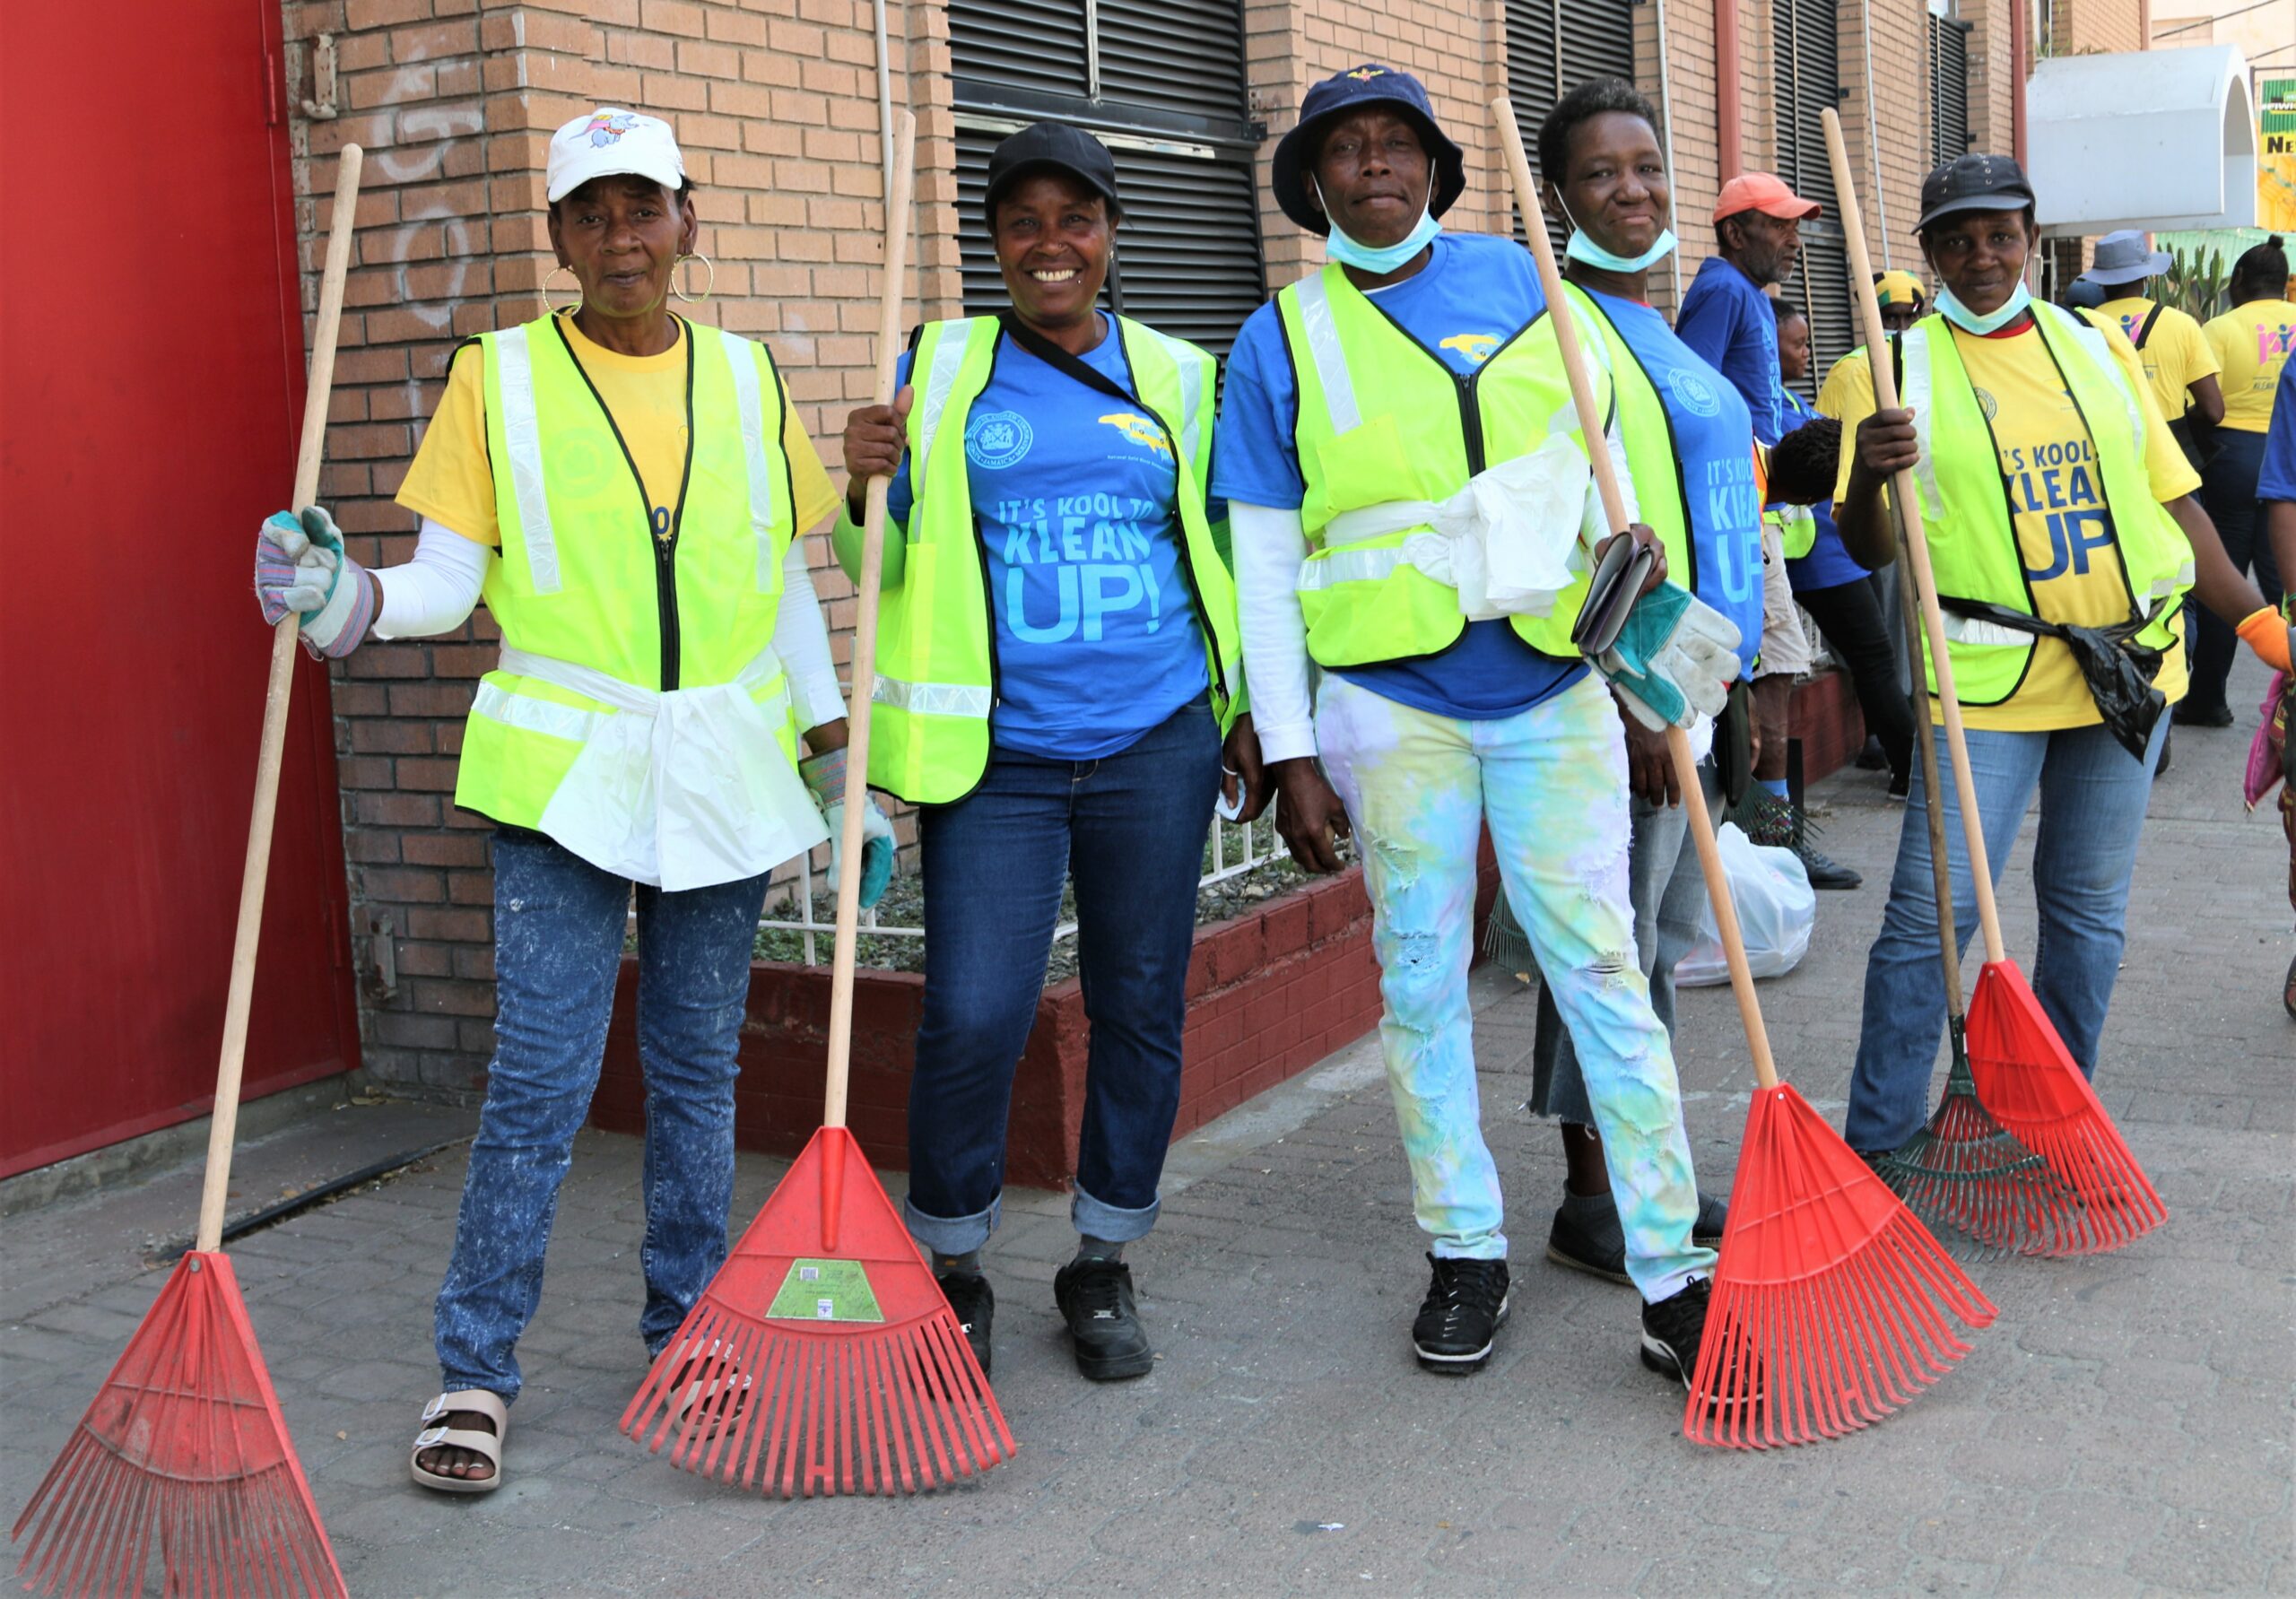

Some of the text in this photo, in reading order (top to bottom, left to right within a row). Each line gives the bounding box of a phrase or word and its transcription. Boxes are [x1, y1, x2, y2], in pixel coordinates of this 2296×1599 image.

[2267, 135, 2296, 154] NE
[2004, 439, 2091, 470] 'S KOOL
[1707, 456, 1753, 487] IT'S KOO
[999, 498, 1047, 524] IT'S
[1057, 492, 1123, 517] KOOL
[1709, 484, 1761, 532] KLEA
[1003, 516, 1152, 564] KLEAN
[1005, 563, 1161, 644] UP!
